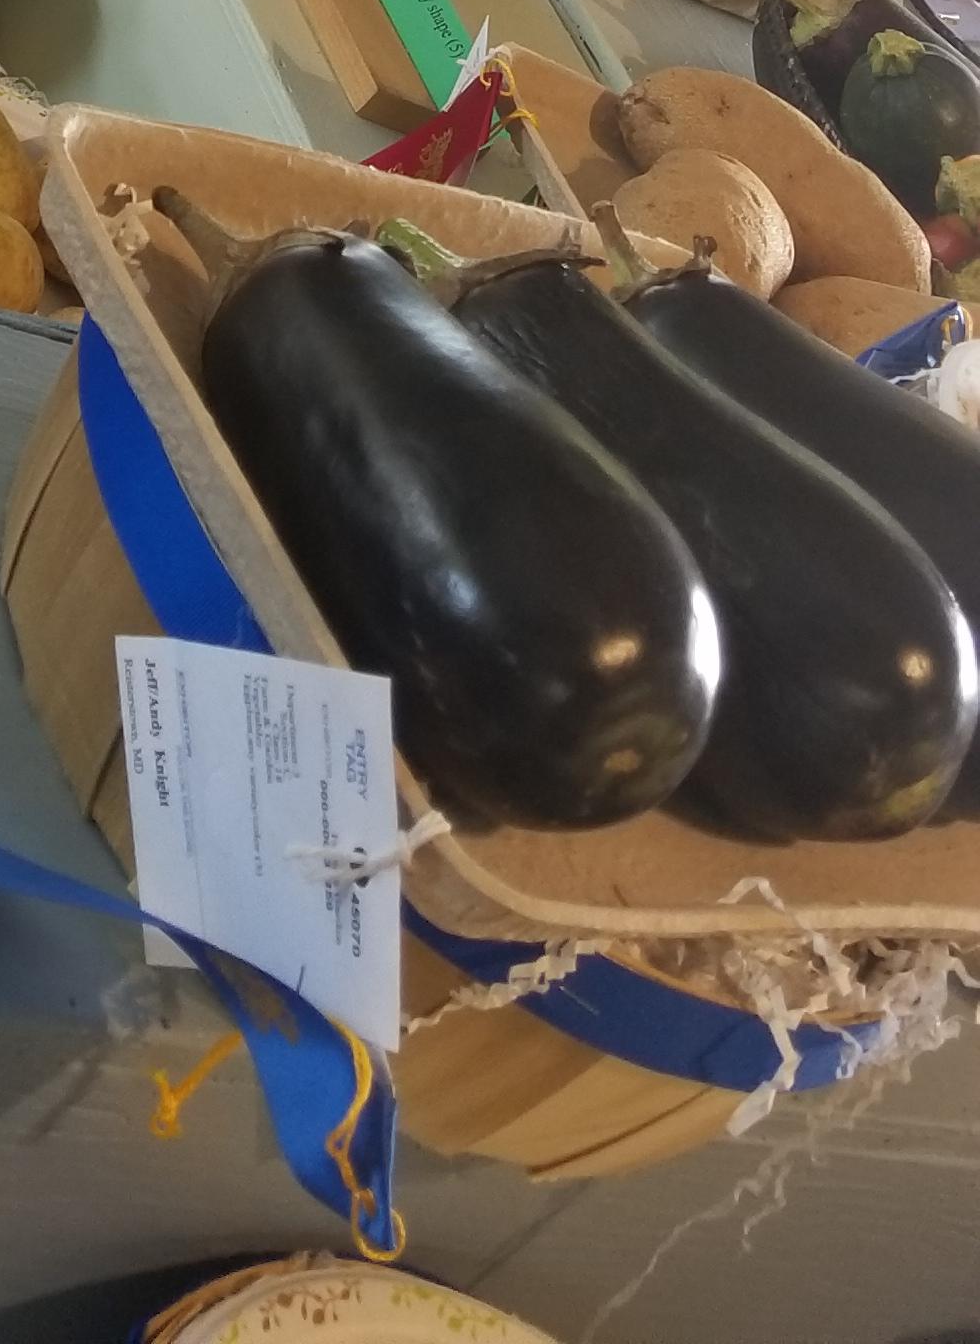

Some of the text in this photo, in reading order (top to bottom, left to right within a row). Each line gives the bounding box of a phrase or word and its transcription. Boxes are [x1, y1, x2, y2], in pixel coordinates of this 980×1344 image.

[427, 4, 452, 39] shape
[445, 38, 465, 59] (5)
[132, 748, 144, 774] MD
[145, 658, 170, 807] Jeff/Andy Knight
[346, 744, 356, 783] TAG
[355, 728, 368, 802] ENTRY
[351, 892, 361, 958] 45070
